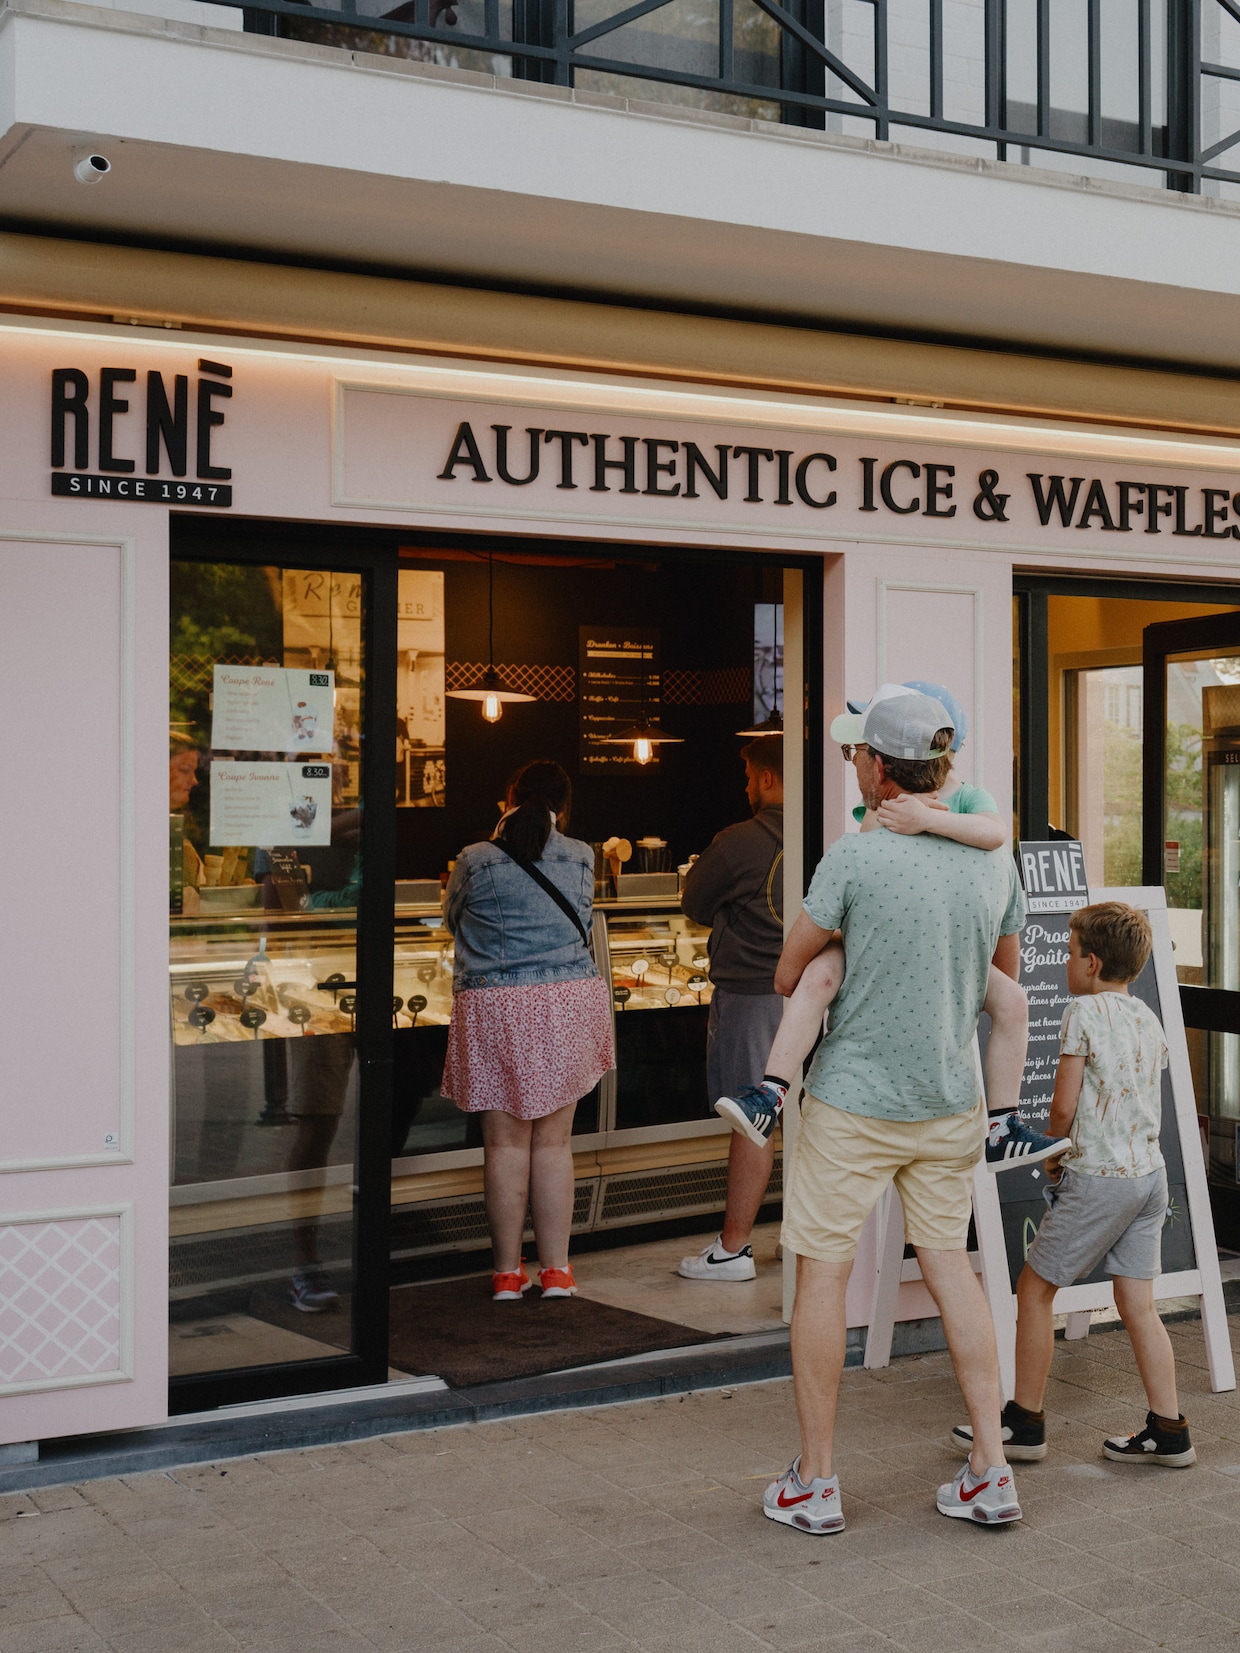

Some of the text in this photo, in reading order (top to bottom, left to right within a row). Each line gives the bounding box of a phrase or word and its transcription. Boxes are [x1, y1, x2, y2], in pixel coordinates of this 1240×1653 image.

[436, 421, 838, 509] AUTHENTIC
[858, 457, 956, 518] ICE
[973, 468, 1011, 522] &
[70, 477, 218, 501] SINCE 1947
[221, 674, 251, 686] Coupe
[218, 771, 246, 784] Coupe
[1031, 899, 1085, 909] SINCE 1947
[1024, 924, 1071, 945] Proe
[1020, 946, 1070, 974] Goûte
[1027, 1071, 1051, 1085] glaces
